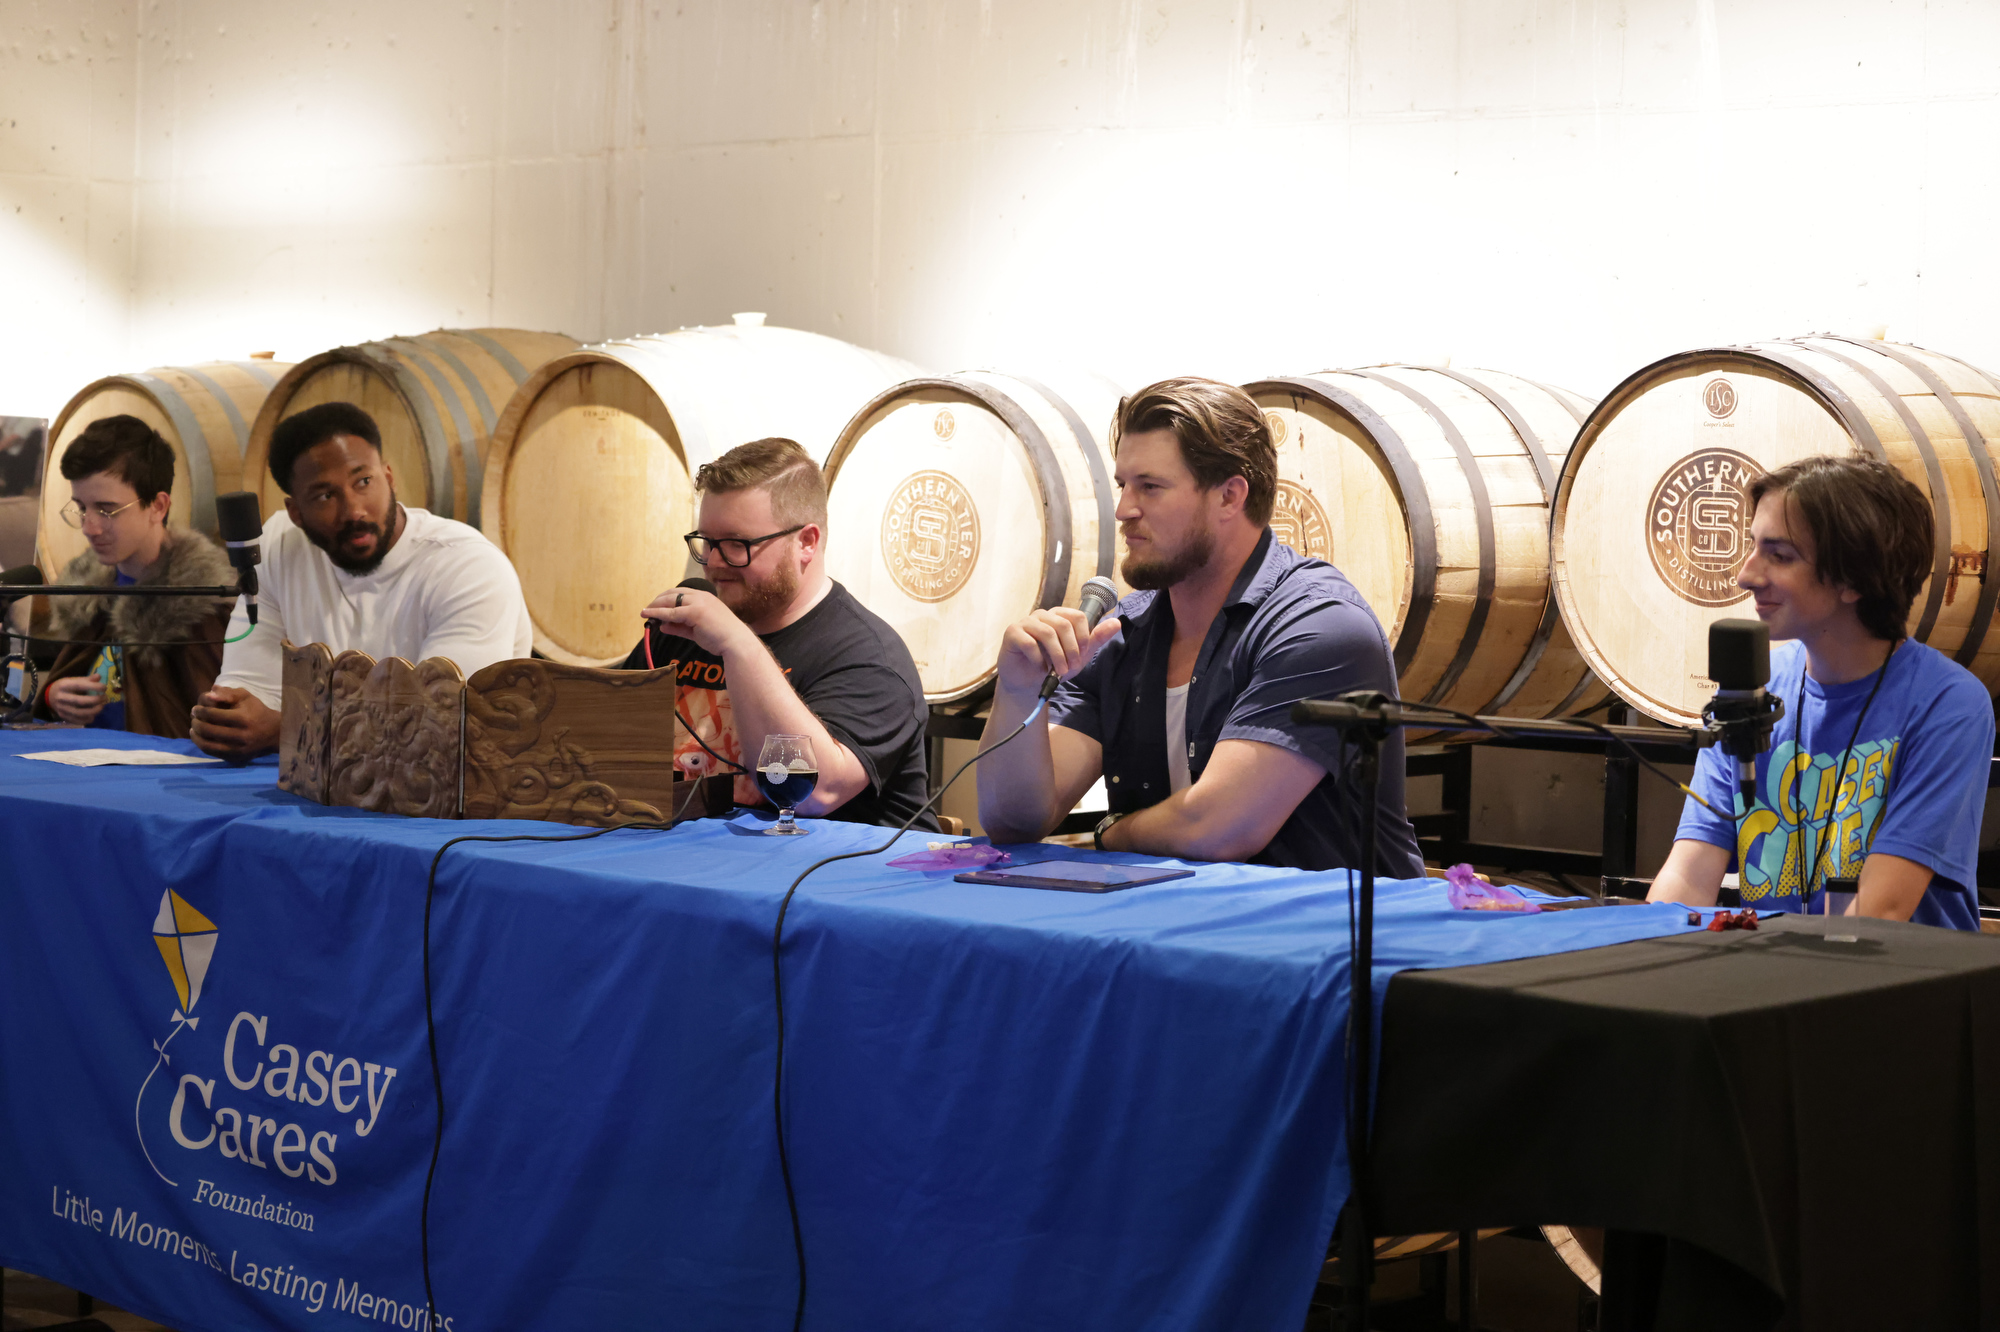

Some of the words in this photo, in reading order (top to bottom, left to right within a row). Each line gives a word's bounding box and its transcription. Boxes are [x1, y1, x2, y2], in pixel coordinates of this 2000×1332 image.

[887, 479, 960, 543] SOUTHERN
[957, 507, 973, 559] TIER
[1656, 459, 1751, 542] SOUTHERN
[894, 556, 943, 589] DISTILLING
[1669, 557, 1738, 591] DISTILLING
[1769, 739, 1900, 826] CASEY
[1737, 806, 1887, 902] CARE
[223, 1011, 397, 1137] Casey
[169, 1074, 337, 1186] Cares
[192, 1179, 314, 1232] Foundation
[52, 1186, 103, 1232] Little
[230, 1250, 327, 1313] Lasting
